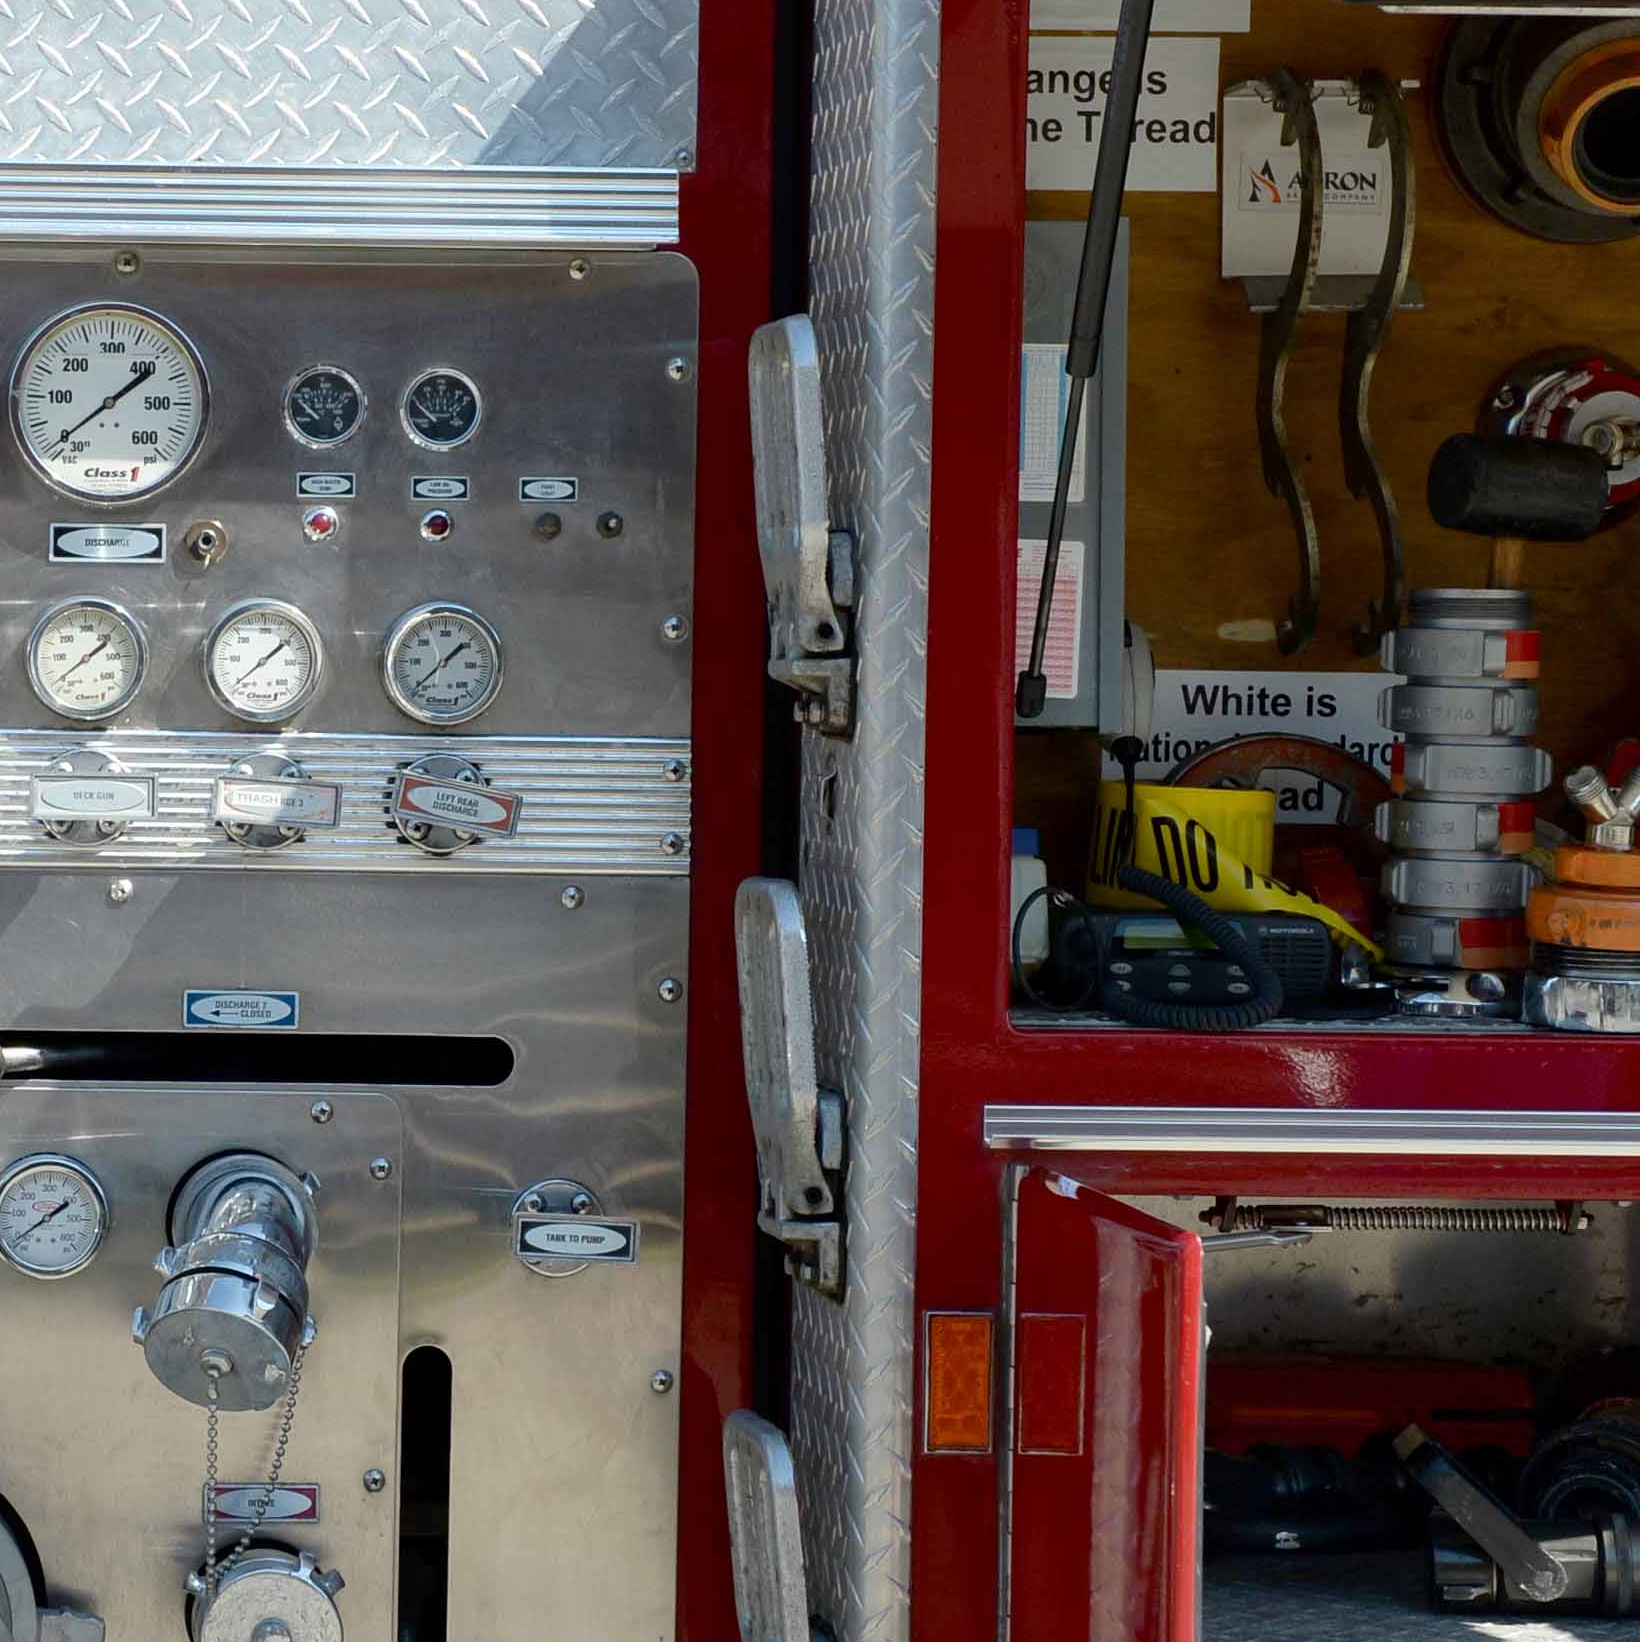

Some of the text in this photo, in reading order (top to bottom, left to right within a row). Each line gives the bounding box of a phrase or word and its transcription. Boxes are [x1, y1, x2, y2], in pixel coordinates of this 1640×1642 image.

[1028, 70, 1113, 102] ange
[1077, 111, 1216, 143] Tread
[1287, 172, 1376, 190] ARON
[99, 342, 125, 354] 300
[62, 358, 88, 372] 200
[129, 361, 156, 375] 400
[47, 390, 72, 404] 100
[144, 397, 170, 411] 500
[132, 431, 158, 445] 600
[84, 468, 126, 478] Class
[59, 634, 74, 644] 200
[53, 653, 66, 661] 100
[106, 653, 121, 662] 500
[100, 671, 115, 681] 600
[1182, 683, 1338, 718] White is
[73, 791, 115, 802] DECK GUN
[436, 791, 480, 808] LEFT REAR
[432, 801, 479, 818] DISCHARGE
[1152, 816, 1219, 893] DO
[216, 1001, 258, 1009] DISCHARGE
[42, 1184, 57, 1194] 300
[20, 1191, 36, 1202] 200
[11, 1208, 27, 1218] 100
[66, 1214, 82, 1224] 500
[545, 1233, 606, 1244] TANK TO PUMP
